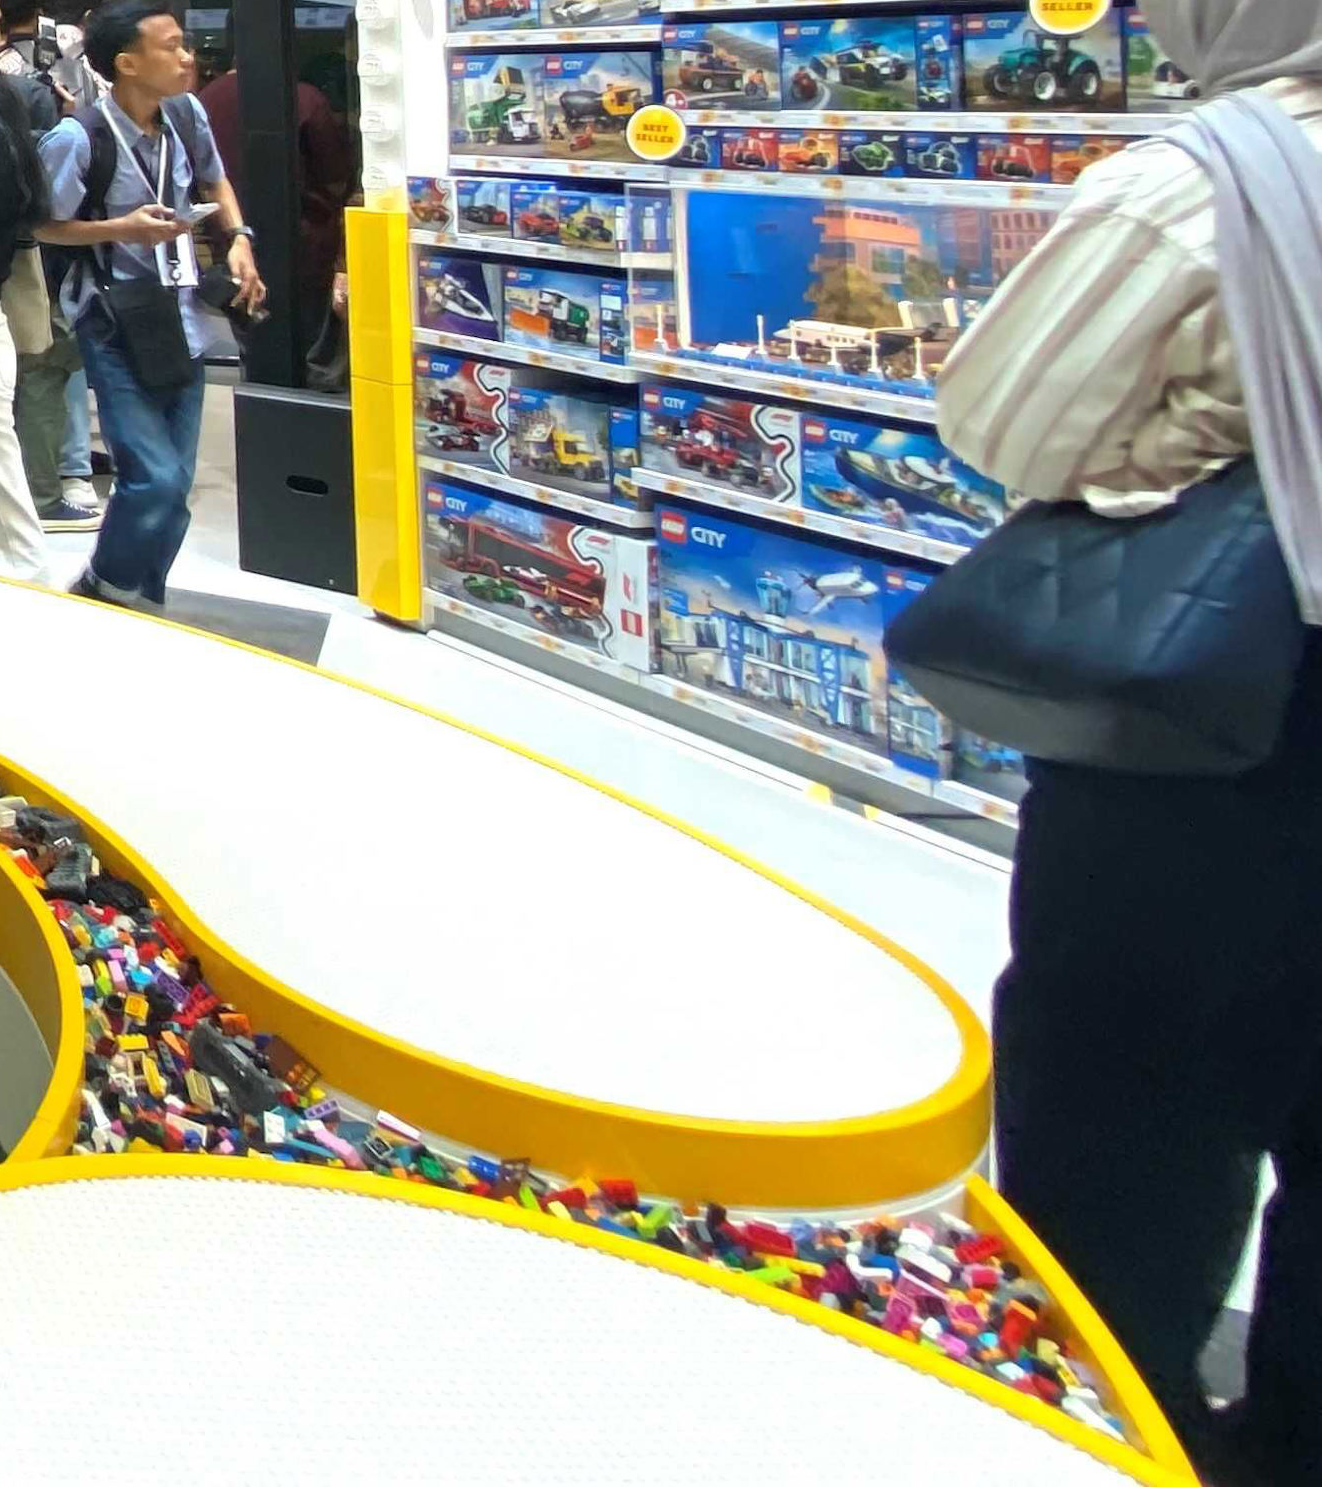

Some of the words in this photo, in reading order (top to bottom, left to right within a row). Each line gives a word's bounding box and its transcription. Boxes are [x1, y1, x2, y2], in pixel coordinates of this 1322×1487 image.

[1042, 2, 1093, 11] SELLER
[987, 19, 1009, 29] CITY
[678, 30, 696, 39] CITY
[800, 26, 820, 35] CITY
[467, 62, 484, 71] CITY
[564, 60, 583, 70] CITY
[431, 362, 450, 373] CITY
[664, 397, 685, 410] CITY
[829, 428, 859, 445] CITY
[445, 496, 468, 513] CITY
[691, 526, 728, 549] CITY
